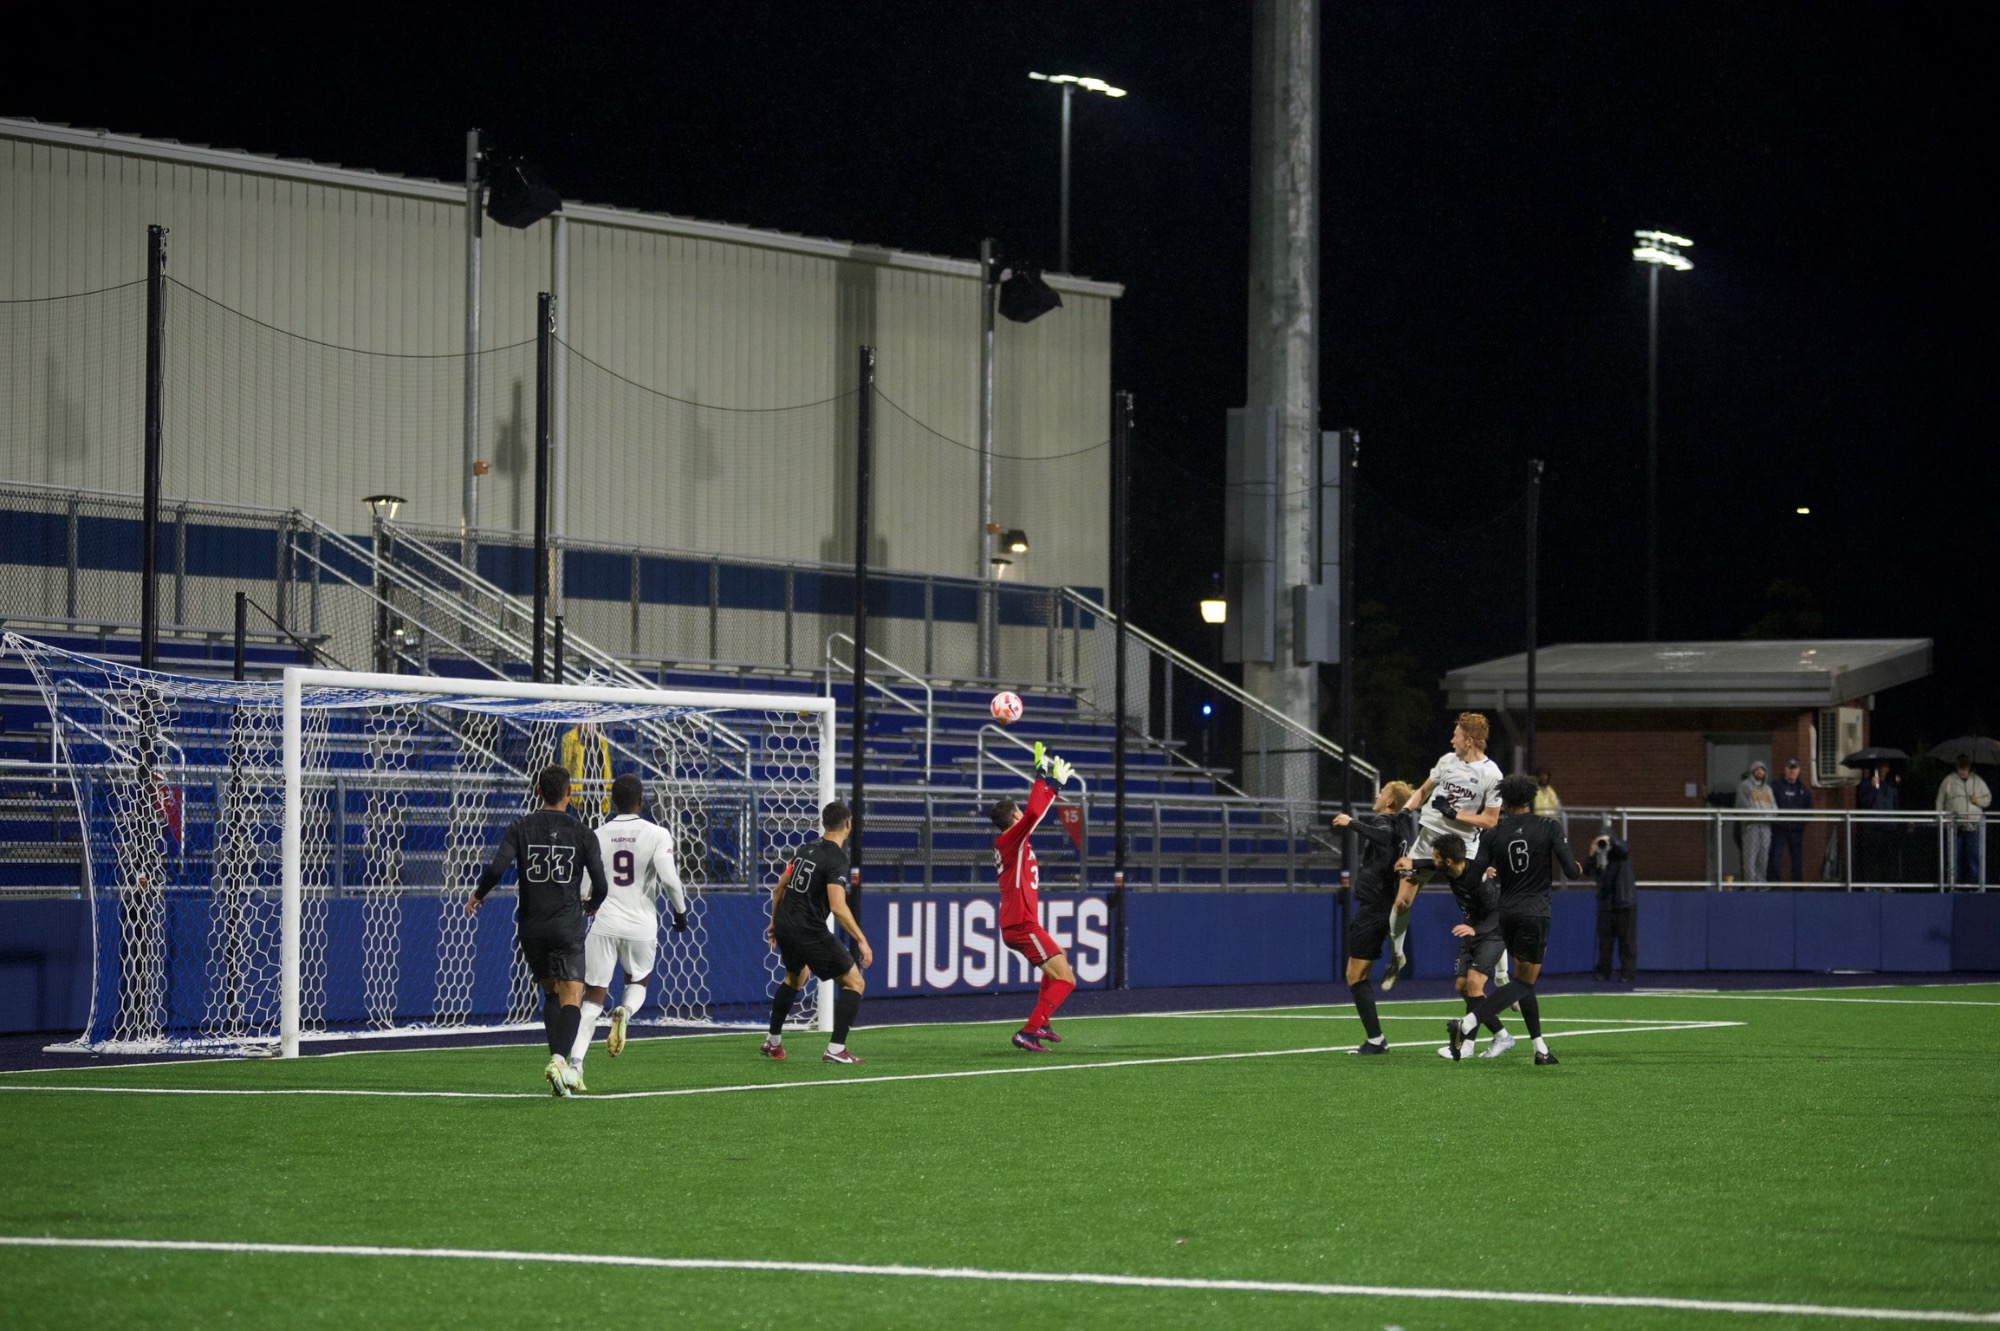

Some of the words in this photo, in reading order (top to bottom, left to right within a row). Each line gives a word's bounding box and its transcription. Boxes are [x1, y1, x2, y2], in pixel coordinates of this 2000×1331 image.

[1443, 780, 1477, 801] UCONN
[1063, 810, 1079, 823] 15
[526, 844, 576, 884] 33
[613, 849, 635, 887] 9
[1508, 839, 1529, 874] 6
[786, 857, 817, 893] 15
